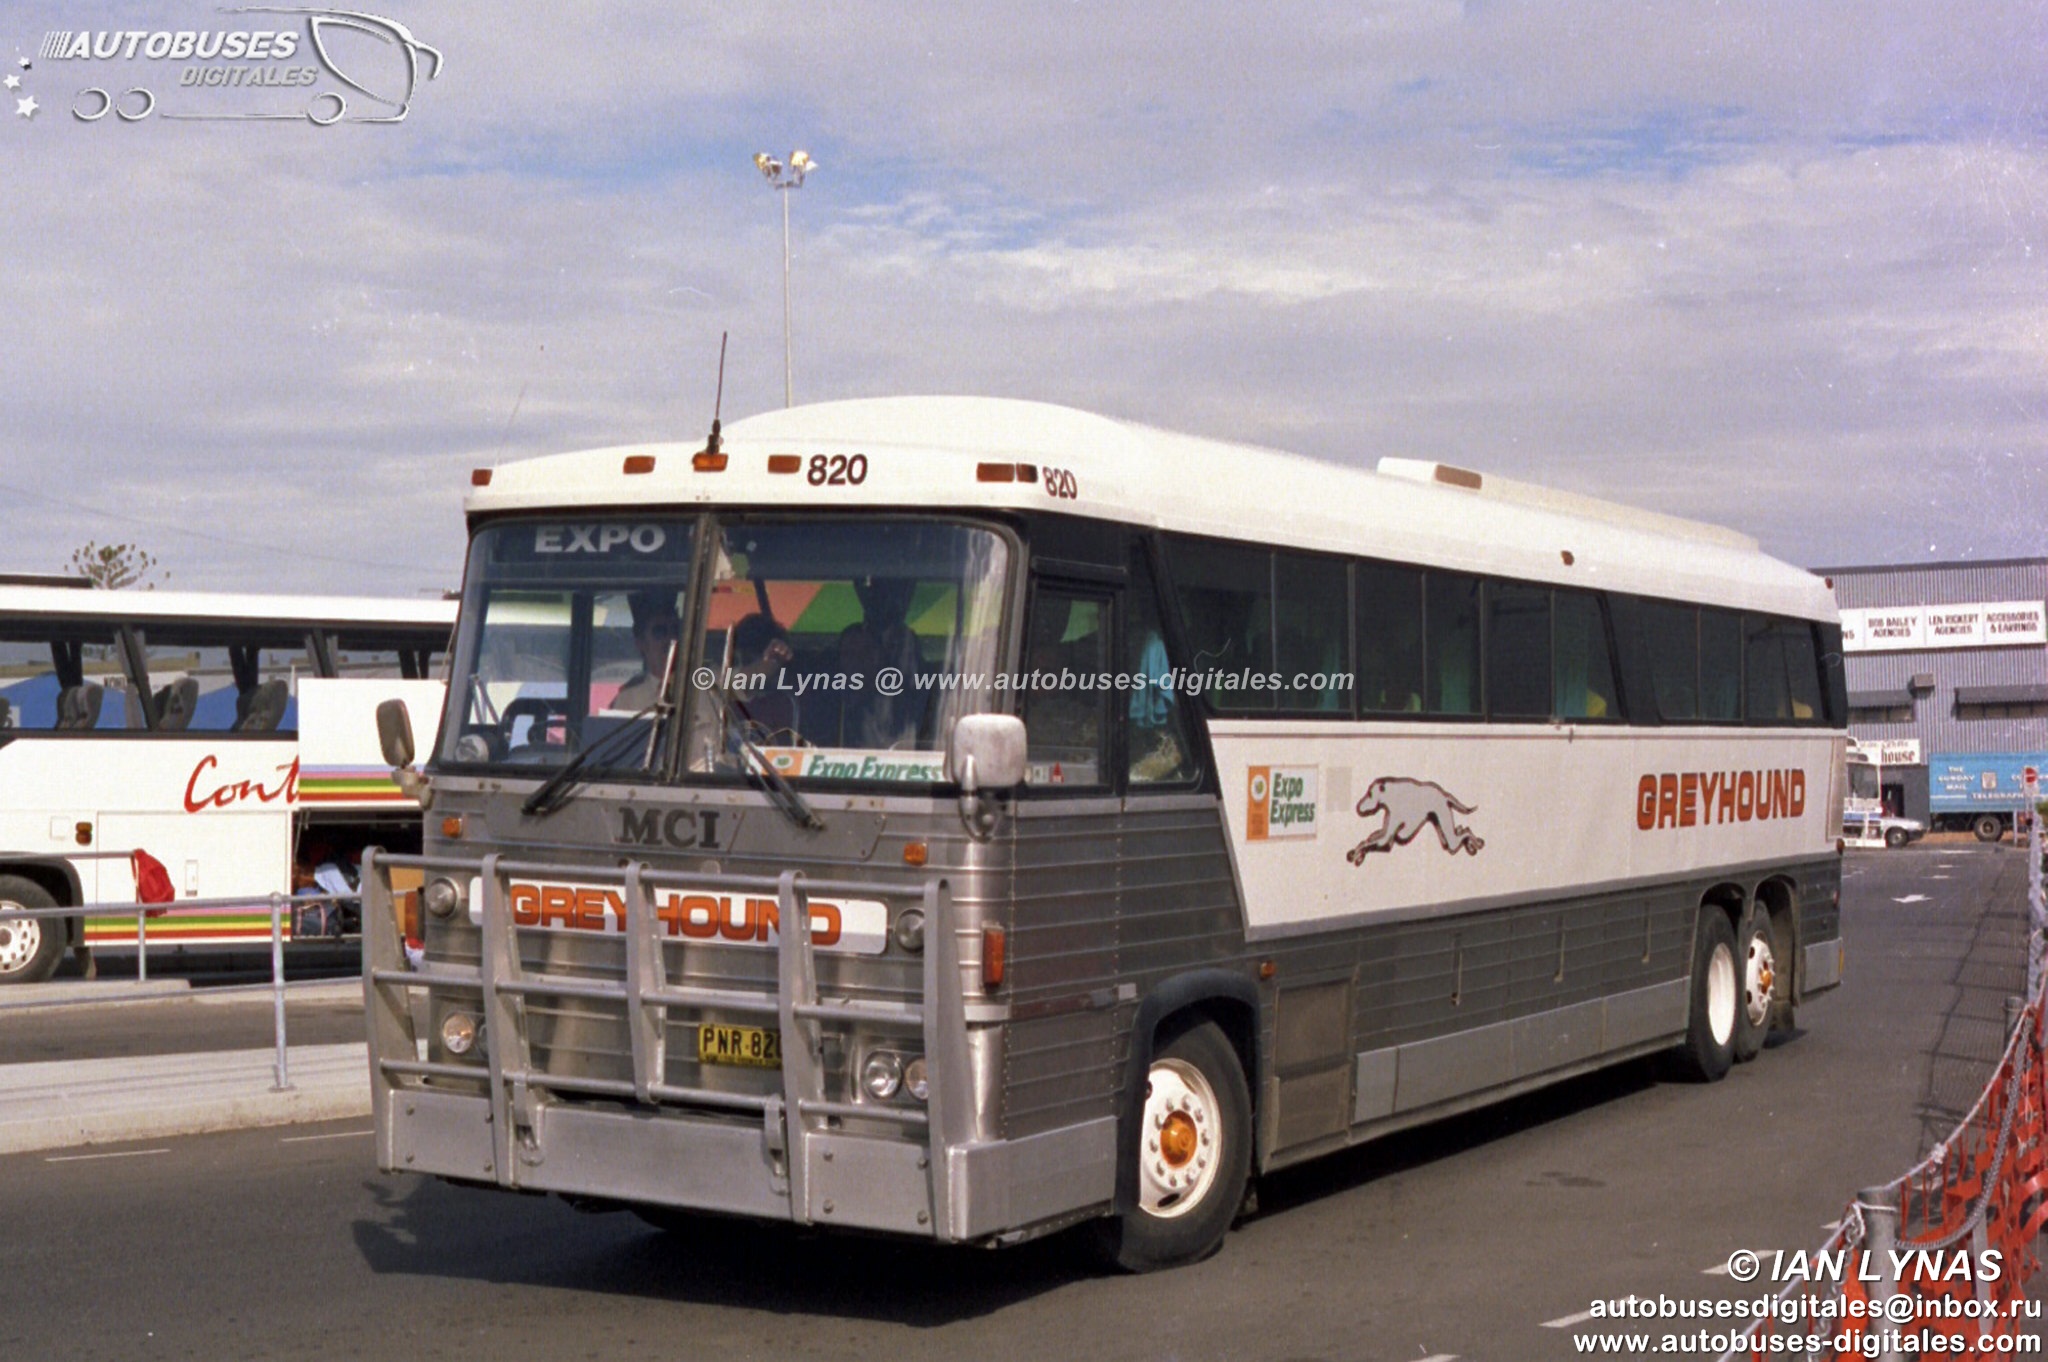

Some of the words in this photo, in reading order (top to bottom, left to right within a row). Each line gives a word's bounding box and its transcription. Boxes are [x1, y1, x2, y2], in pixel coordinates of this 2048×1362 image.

[807, 453, 868, 486] 820
[1042, 467, 1078, 499] 820
[535, 523, 666, 554] EXPO
[1873, 627, 1911, 638] AGENCIES
[1934, 624, 1972, 636] AGENCIES
[808, 755, 858, 780] Expo
[1273, 772, 1304, 802] Expo
[1636, 768, 1806, 831] GREYHOUND
[618, 807, 720, 849] MCI
[1269, 799, 1316, 829] Express
